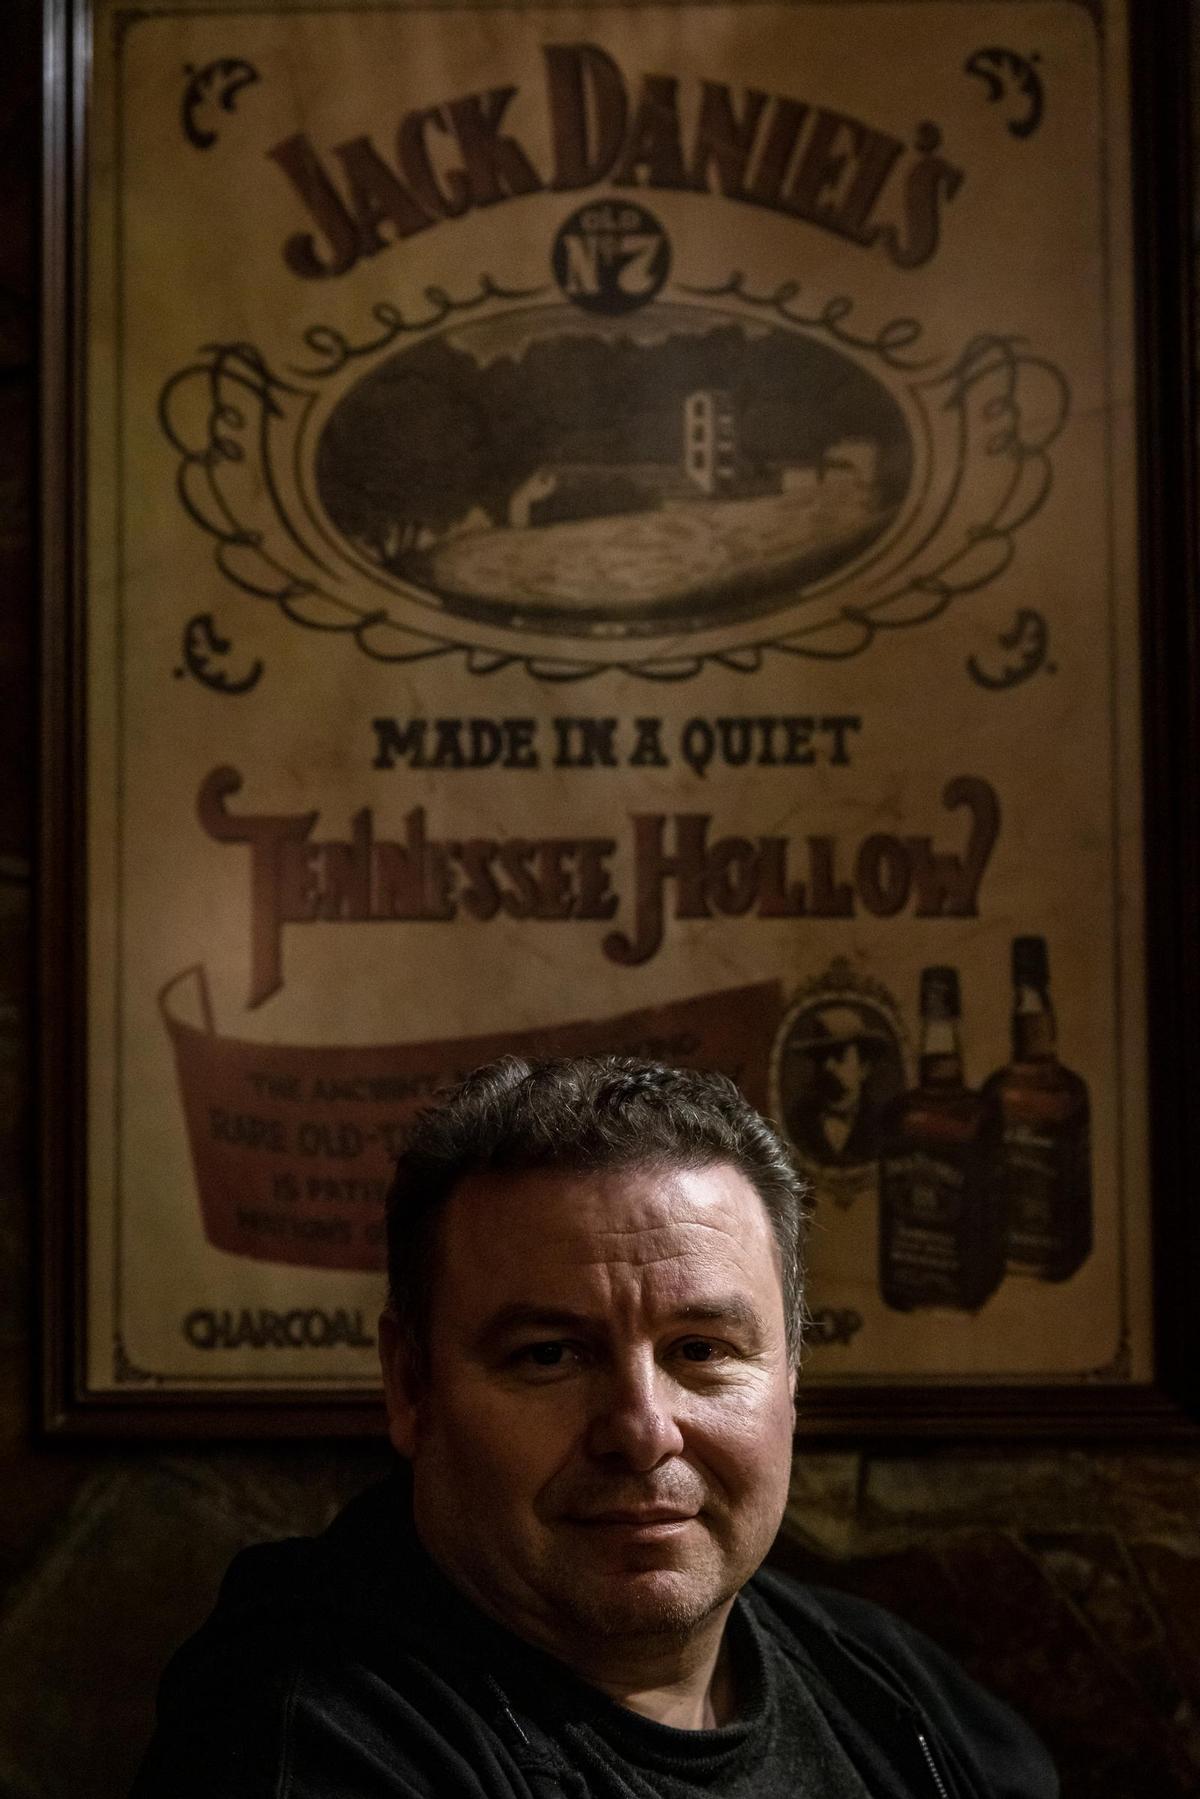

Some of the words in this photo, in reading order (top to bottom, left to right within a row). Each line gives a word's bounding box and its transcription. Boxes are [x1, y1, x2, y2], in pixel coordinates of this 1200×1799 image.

[268, 86, 546, 277] JACK
[541, 42, 964, 269] DANIEL'S
[372, 717, 539, 770] MADE
[553, 717, 618, 769] IN
[629, 717, 670, 769] A
[680, 715, 862, 776] QUIET
[601, 776, 1000, 966] HOLLOW
